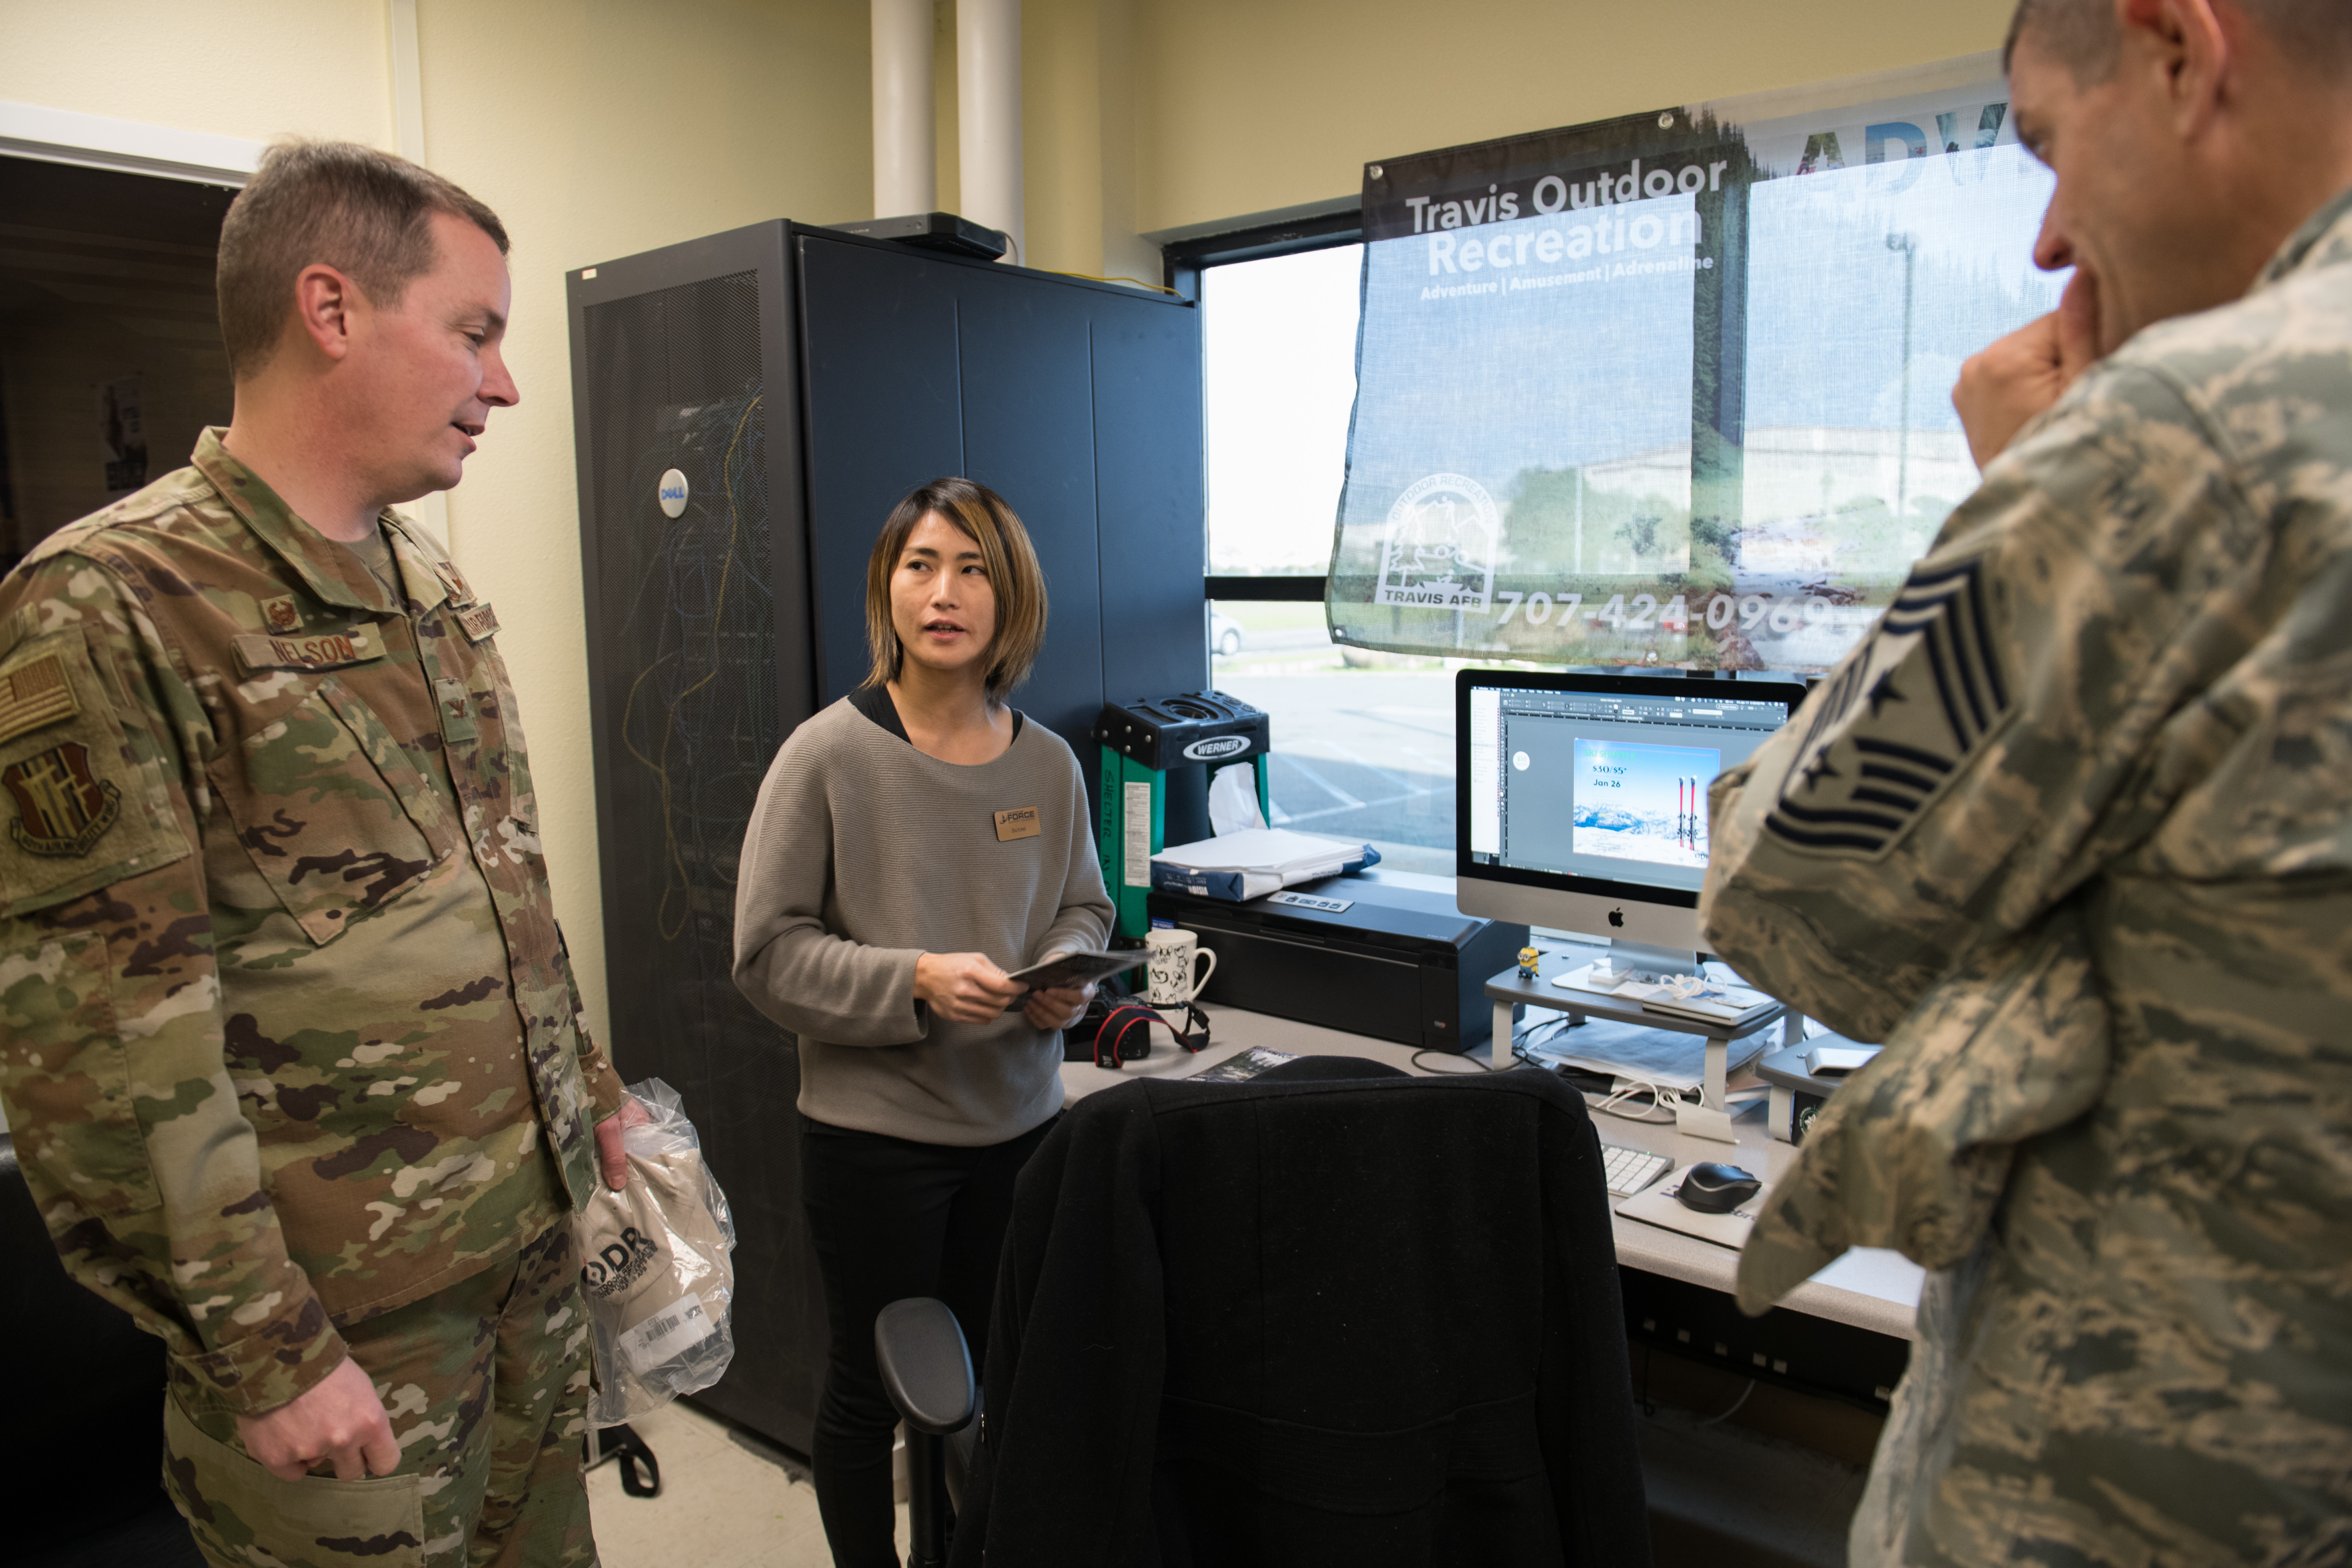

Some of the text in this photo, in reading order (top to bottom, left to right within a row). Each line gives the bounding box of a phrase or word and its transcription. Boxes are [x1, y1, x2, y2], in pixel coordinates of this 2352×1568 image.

[1405, 158, 1727, 233] Travis Outdoor
[1429, 202, 1702, 276] Recreation
[1421, 277, 1498, 300] Adventure
[1510, 266, 1601, 292] Amusement
[1612, 254, 1714, 279] Adrenaline
[661, 487, 684, 500] DELL
[1391, 476, 1494, 524] OUTDOOR RECREATION
[1385, 590, 1481, 608] TRAVIS AFB
[1498, 591, 1834, 633] 707-424-0969
[269, 635, 356, 665] NELSON
[1197, 739, 1239, 755] WERNER
[1600, 751, 1636, 760] SHUTTLE
[1007, 810, 1035, 821] FORCE
[1103, 769, 1115, 838] SHELTER
[1187, 885, 1209, 896] VISION
[581, 1227, 656, 1287] ODR
